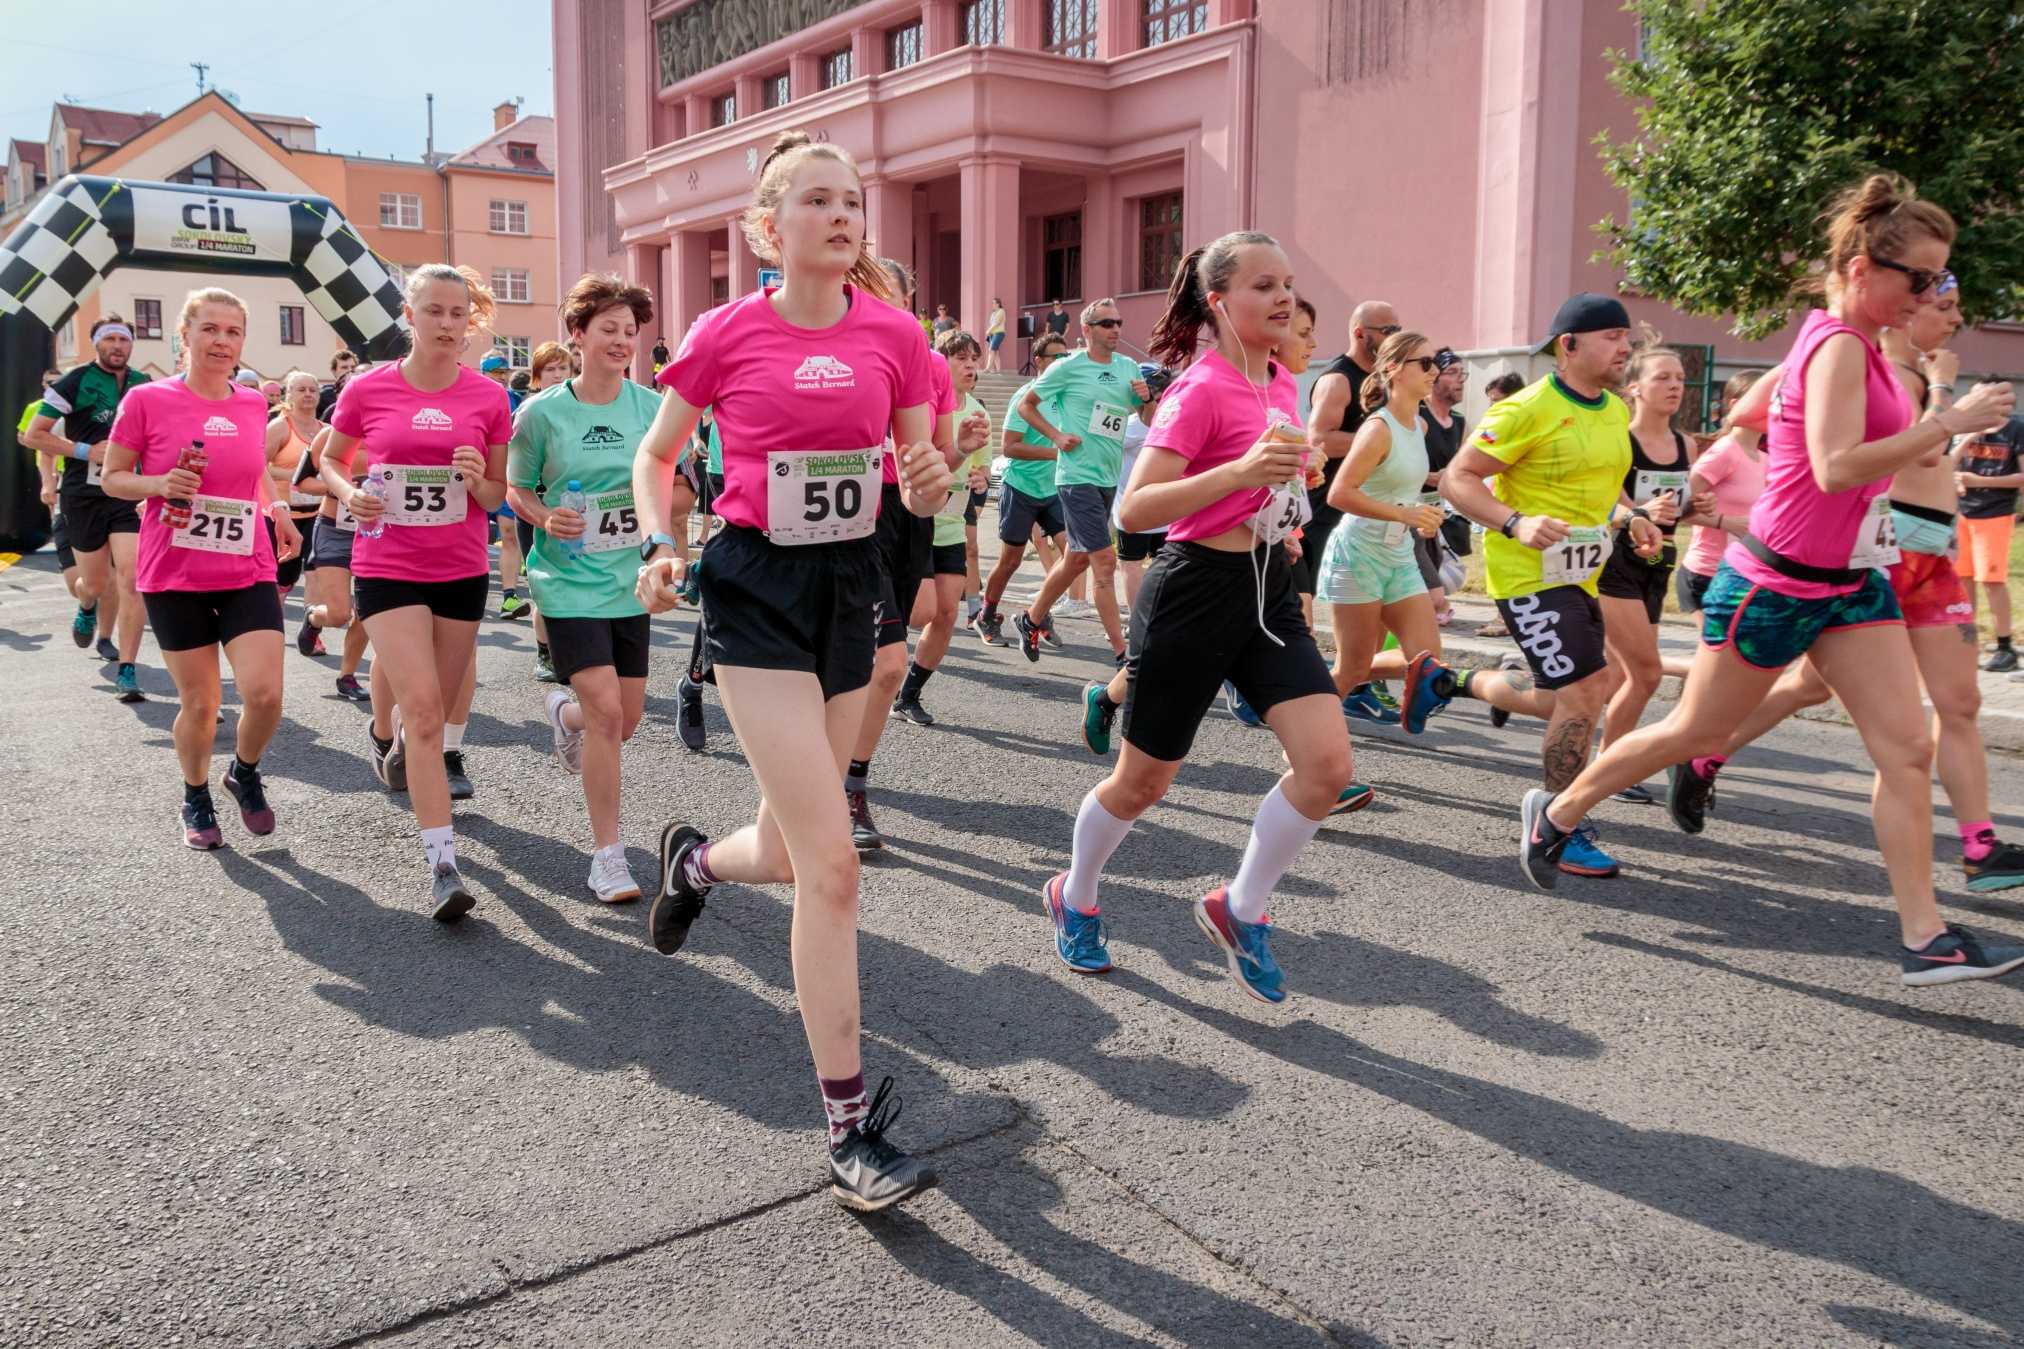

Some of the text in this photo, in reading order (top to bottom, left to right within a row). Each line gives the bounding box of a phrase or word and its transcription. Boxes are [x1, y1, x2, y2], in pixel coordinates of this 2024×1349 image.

[822, 378, 856, 389] Bernard
[1102, 415, 1121, 432] 46
[824, 462, 863, 475] MARATON
[404, 486, 446, 512] 53
[803, 479, 862, 522] 50
[1651, 488, 1684, 507] 11
[190, 513, 243, 541] 215
[599, 508, 638, 536] 45
[1561, 544, 1602, 570] 112
